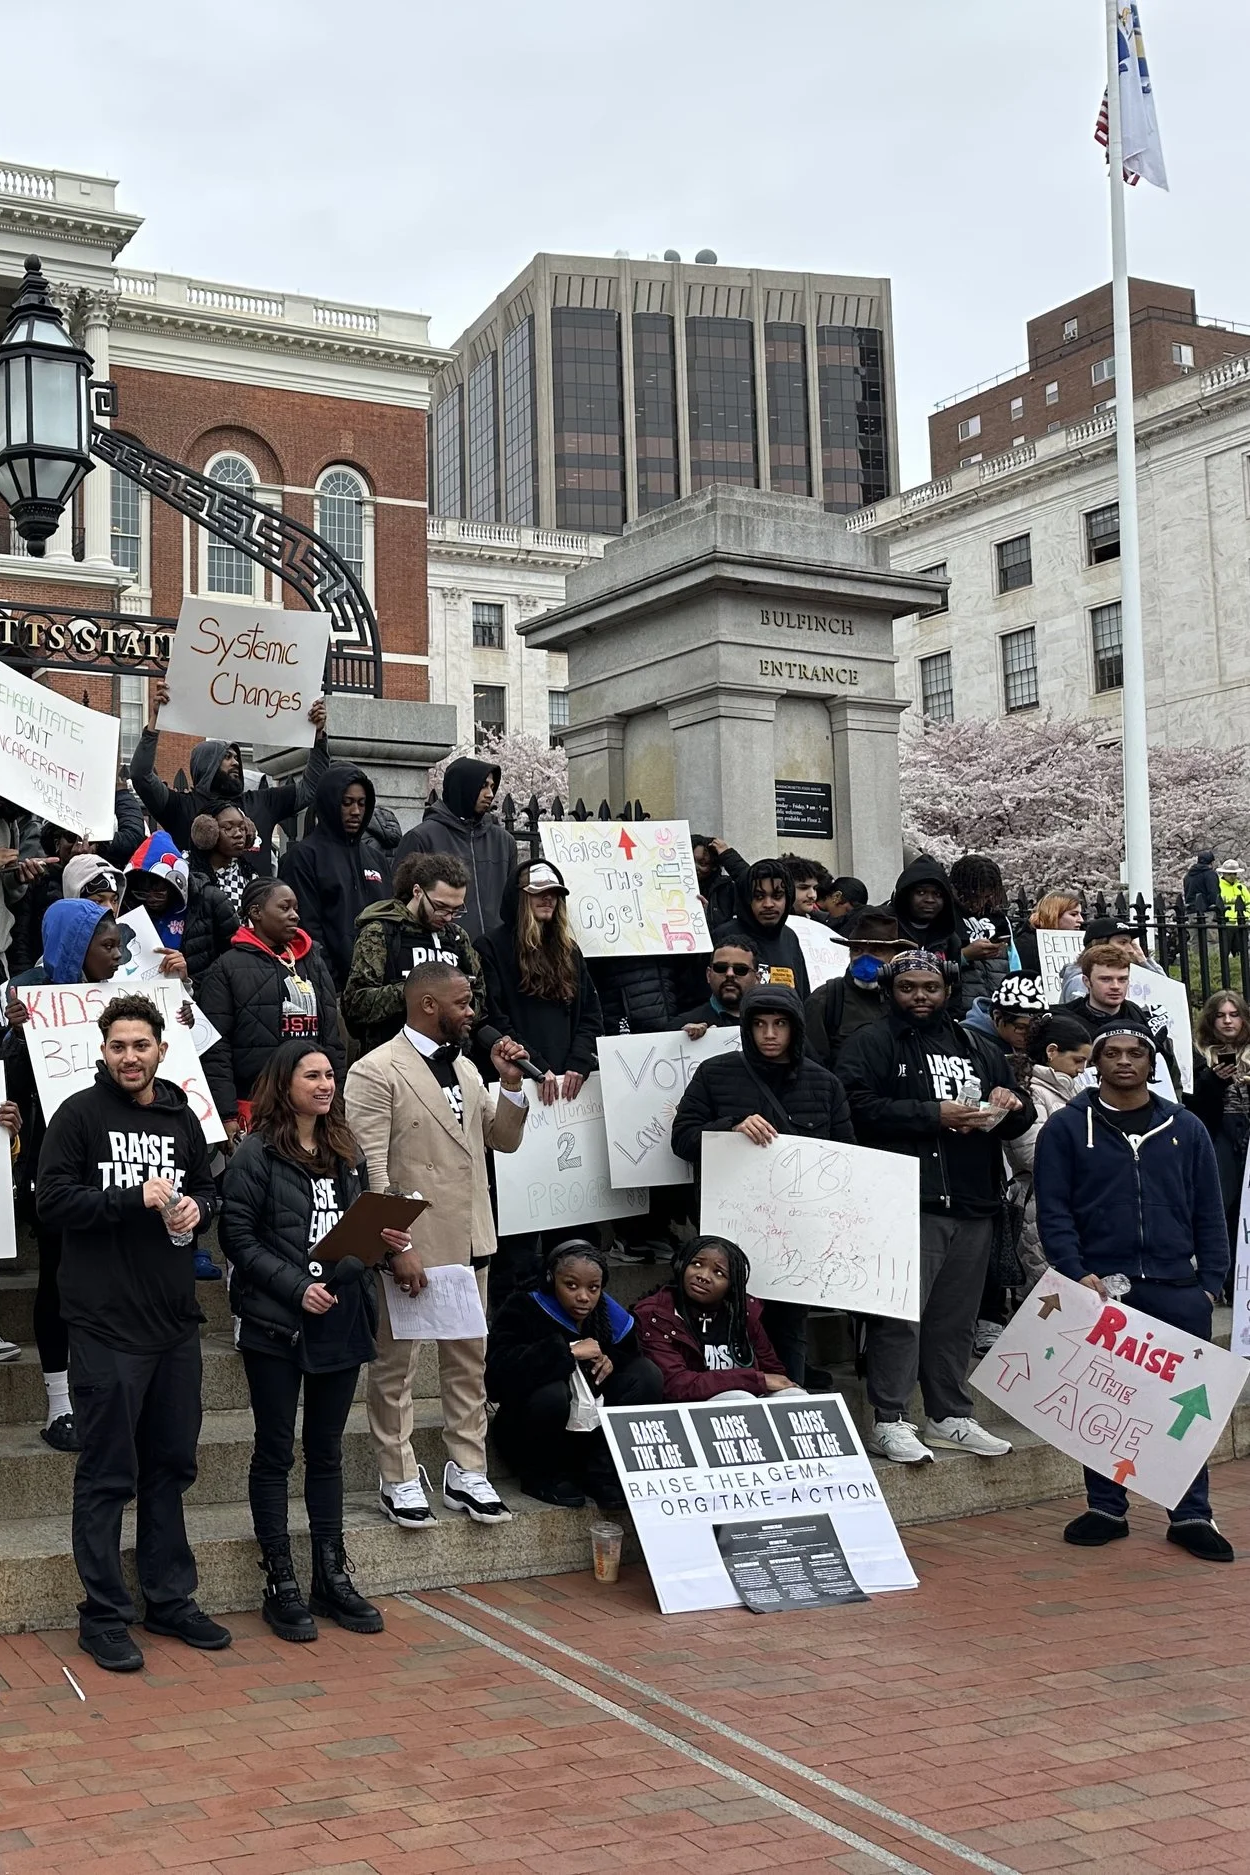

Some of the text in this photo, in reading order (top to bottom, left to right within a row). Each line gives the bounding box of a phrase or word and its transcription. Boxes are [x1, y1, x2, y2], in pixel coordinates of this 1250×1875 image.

[760, 609, 854, 636] BULFINCH
[190, 617, 299, 666] Systemic
[759, 659, 859, 686] ENTRANCE
[210, 672, 302, 718] Changes
[16, 715, 53, 749] DON'T
[579, 889, 645, 944] Age!
[27, 988, 105, 1030] KIDS
[108, 1131, 175, 1167] RAISE
[557, 1131, 582, 1171] 2
[98, 1162, 144, 1192] THE
[527, 1175, 647, 1220] PROGRSS
[1088, 1358, 1138, 1406] THE
[629, 1420, 671, 1446] RAISE
[709, 1414, 751, 1440] RAISE
[787, 1409, 829, 1435] RAISE
[1033, 1382, 1154, 1463] AGE
[631, 1443, 686, 1470] THE AGE
[712, 1438, 766, 1465] THE AGE
[790, 1432, 844, 1459] THE AGE
[628, 1475, 702, 1498] RAISE
